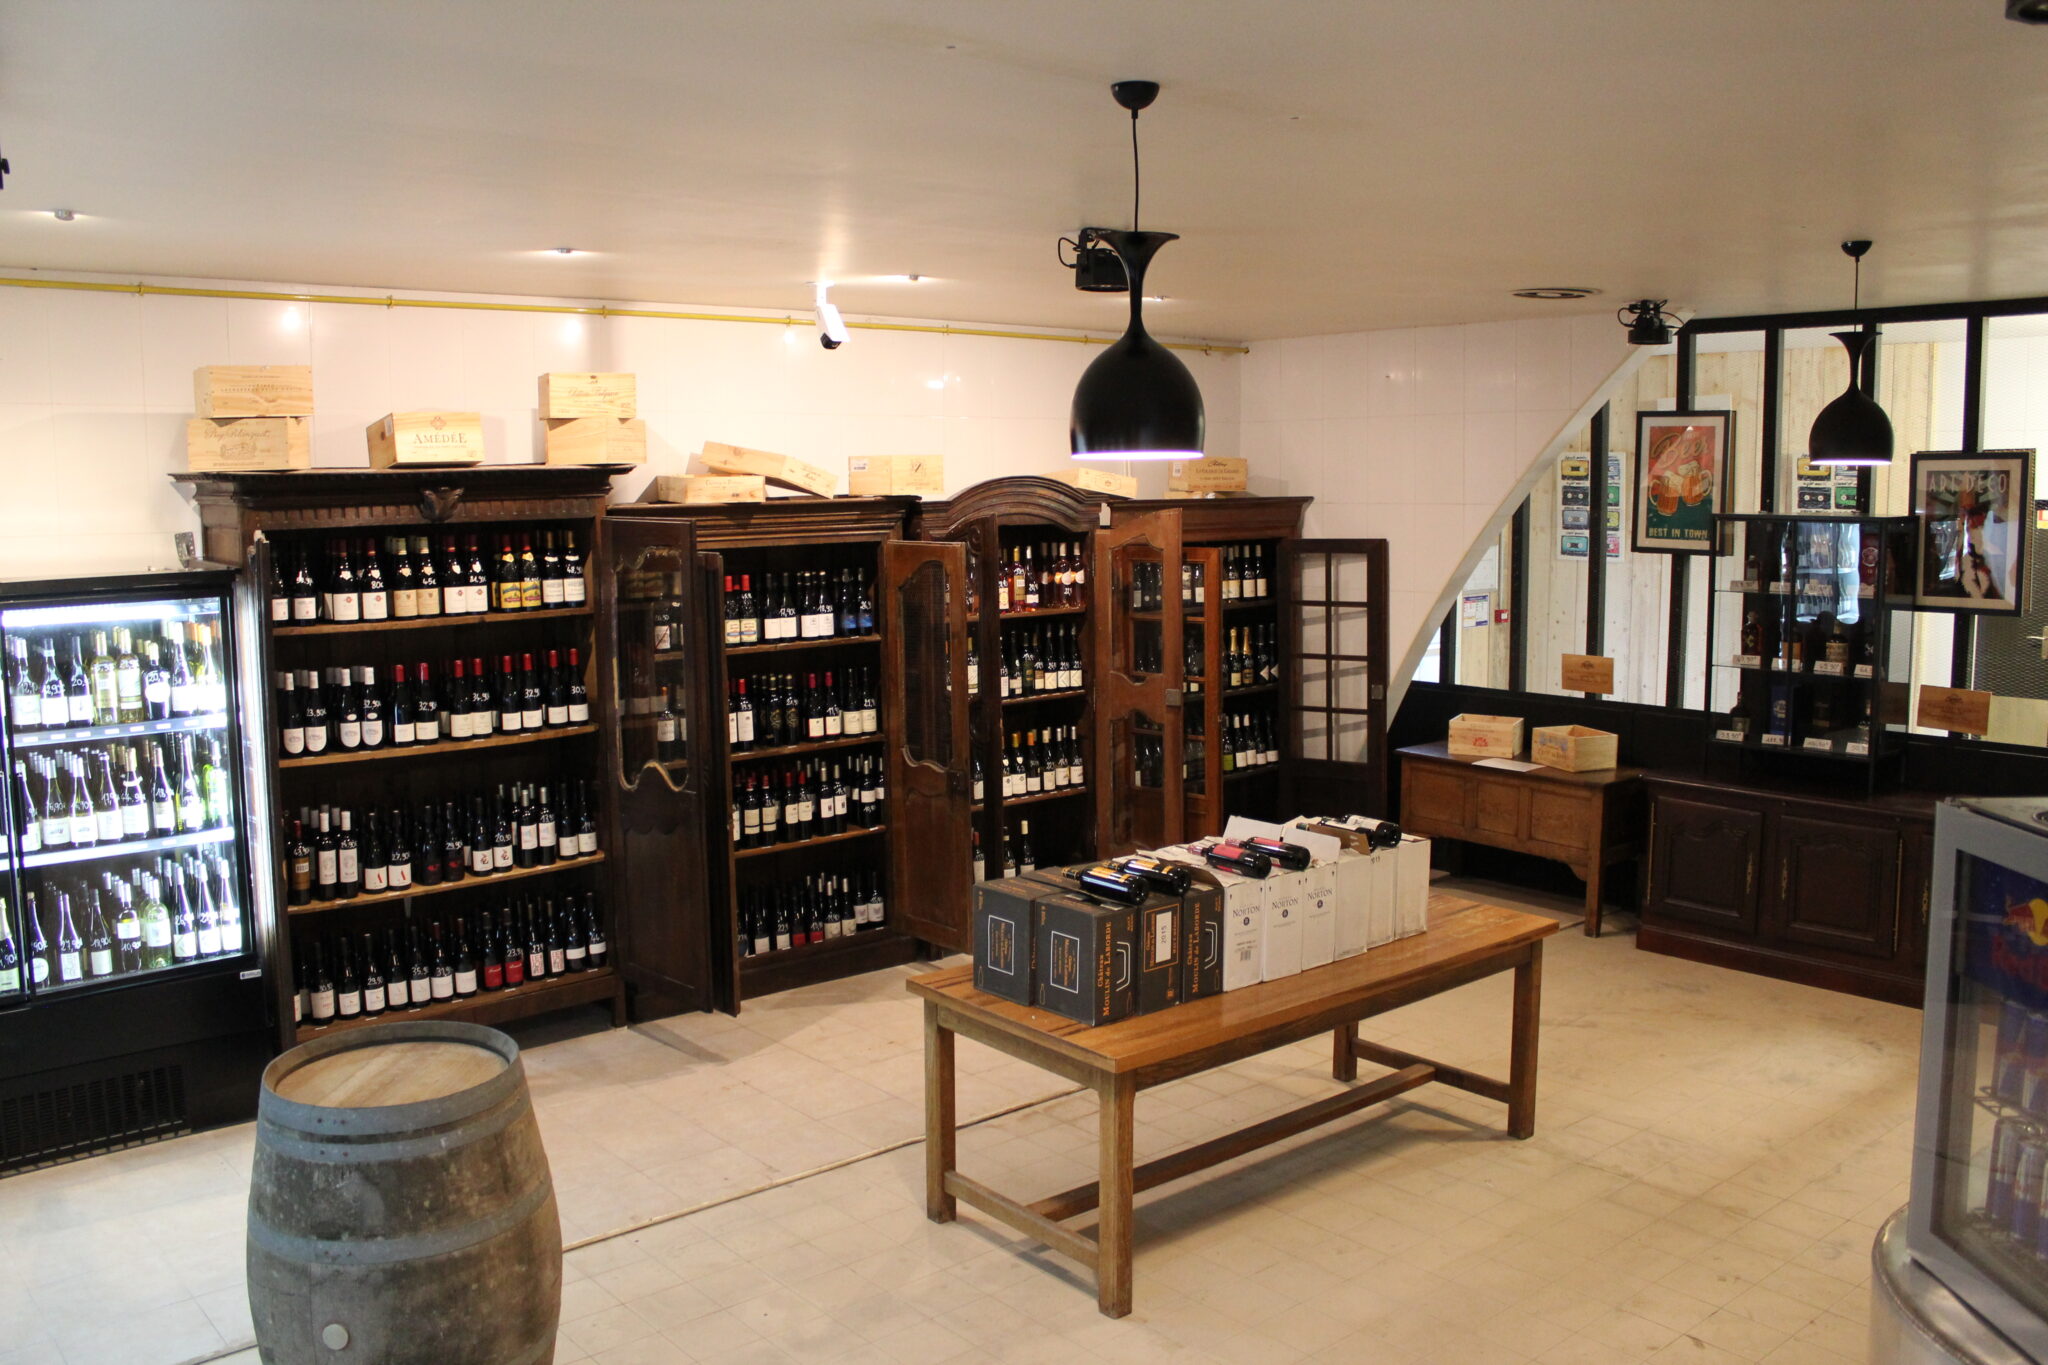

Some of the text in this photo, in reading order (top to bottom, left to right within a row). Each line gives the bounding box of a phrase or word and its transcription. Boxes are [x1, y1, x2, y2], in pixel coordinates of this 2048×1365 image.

[413, 432, 467, 444] AMÉDÉE
[1650, 432, 1711, 470] Beer
[1928, 472, 2007, 493] ART DECO
[1648, 527, 1708, 539] BEST IN TOWN
[1307, 888, 1333, 901] NORTON
[1232, 905, 1260, 919] NORTON
[1272, 897, 1299, 910] NORTON
[1103, 921, 1112, 965] LABORDE
[1192, 957, 1200, 993] MOULIN
[1103, 979, 1111, 1017] MOULIN
